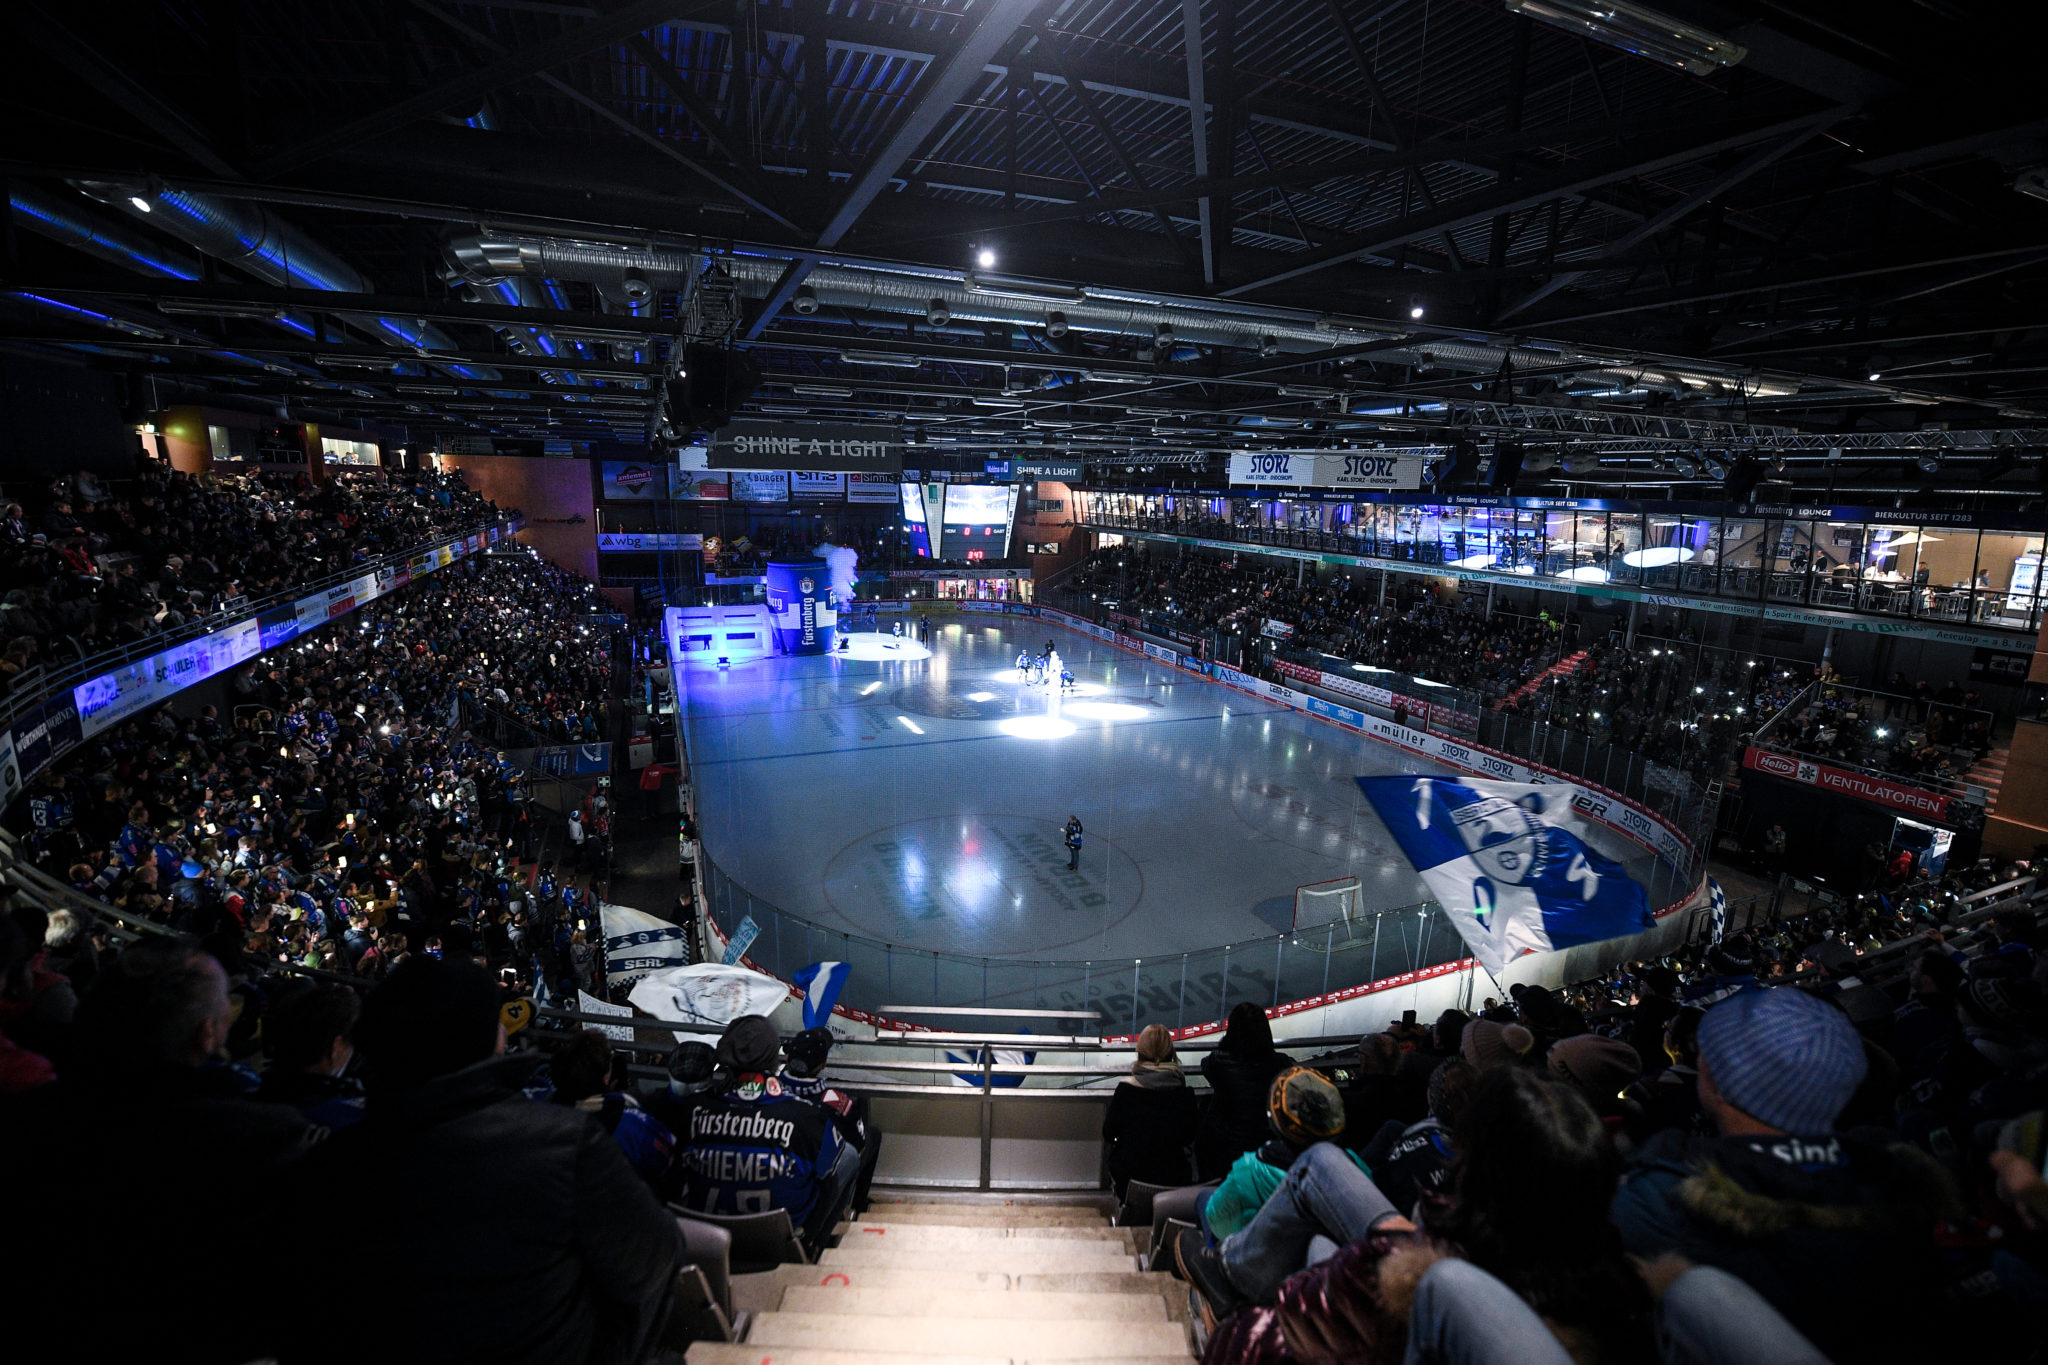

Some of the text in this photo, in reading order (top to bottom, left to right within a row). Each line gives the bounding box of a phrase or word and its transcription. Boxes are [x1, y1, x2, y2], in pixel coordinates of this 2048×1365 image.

[733, 435, 889, 458] SHINE A LIGHT
[1017, 466, 1077, 476] SHINE A LIGHT
[1251, 454, 1289, 473] STORZ
[1344, 456, 1394, 477] STORZ
[754, 474, 785, 482] BURGER
[1754, 505, 1972, 522] Fürstenberg LOUNGE BIERKULTUR SEIT 1283
[615, 536, 641, 548] wbg
[801, 597, 815, 646] Fürstenberg
[1699, 600, 1713, 608] Wir
[1713, 602, 1755, 615] unterstützen
[1771, 610, 1792, 620] Sport
[1803, 613, 1816, 622] der
[1818, 615, 1844, 627] Region
[1937, 631, 1979, 644] Aesculap
[155, 656, 197, 684] SCHULER
[1337, 708, 1354, 721] stein
[1381, 723, 1426, 747] müller
[1441, 743, 1470, 761] STORZ
[1483, 757, 1514, 776] STORZ
[1760, 756, 1940, 813] Helios VENTILATOREN
[1623, 809, 1652, 834] STORZ
[690, 1104, 795, 1149] Fürstenberg
